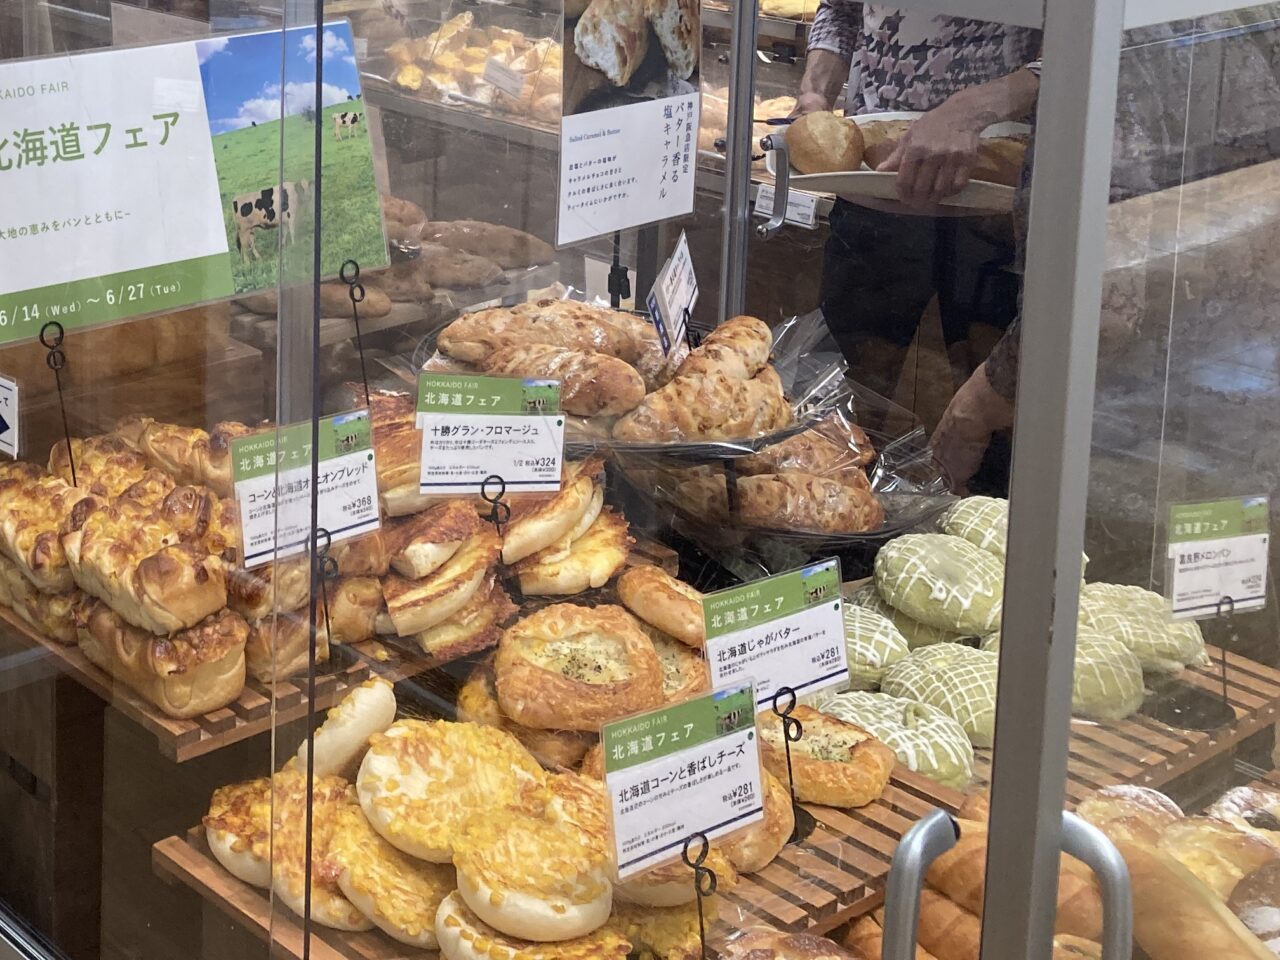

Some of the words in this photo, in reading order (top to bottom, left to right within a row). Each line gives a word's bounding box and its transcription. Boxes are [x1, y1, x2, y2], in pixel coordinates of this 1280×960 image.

[40, 81, 70, 95] FAIR
[659, 105, 672, 200] 塩キャラメル
[672, 102, 684, 182] バター香る
[45, 300, 81, 320] (Wed)
[105, 284, 145, 305] 6/27
[150, 280, 181, 299] (Tue)
[426, 381, 462, 389] HOKKAIDO
[424, 392, 501, 407] 北海道フェア
[431, 424, 539, 437] 十勝グラン・フロマージュ
[238, 439, 275, 452] HOKKAIDO
[239, 445, 312, 472] 北海道フェア
[710, 596, 745, 610] HOKKAIDO
[747, 590, 760, 600] FAIR
[711, 597, 784, 628] 北海道フェア
[717, 626, 800, 663] 北海道じゃがバター
[611, 721, 650, 738] HOKKAIDO
[652, 715, 668, 728] FAIR
[612, 723, 694, 761] 北海道フェア
[618, 742, 745, 805] 北海道コーンと香ばしチーズ
